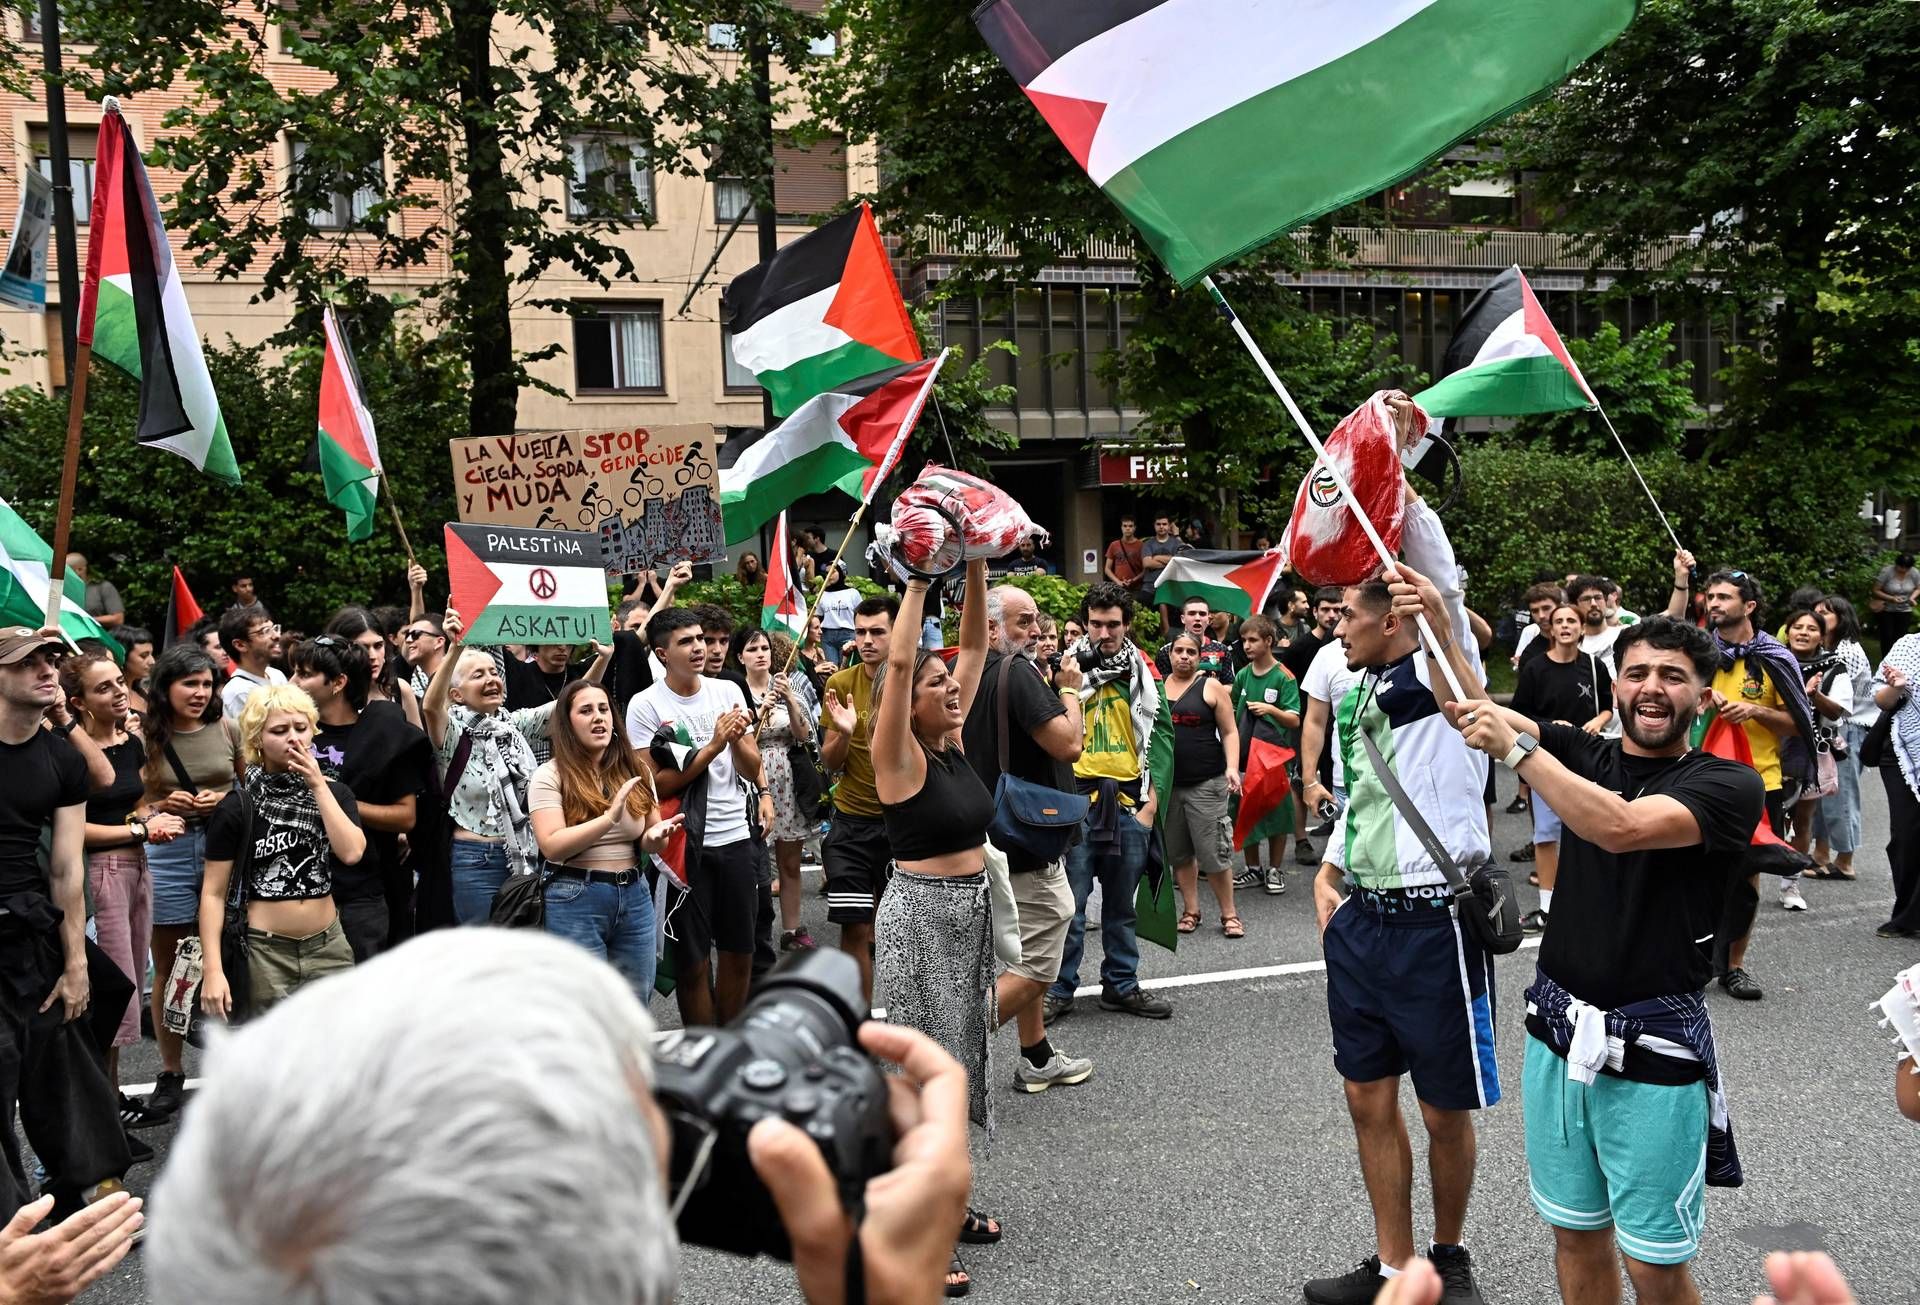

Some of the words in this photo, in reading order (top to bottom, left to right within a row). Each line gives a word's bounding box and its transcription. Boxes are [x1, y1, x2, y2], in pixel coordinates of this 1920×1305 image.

[464, 444, 492, 463] LA
[496, 434, 574, 462] VUELTA
[583, 428, 650, 458] STOP
[533, 459, 596, 479] SORDA,
[486, 478, 572, 512] MUDA
[497, 613, 597, 640] ASKATU!
